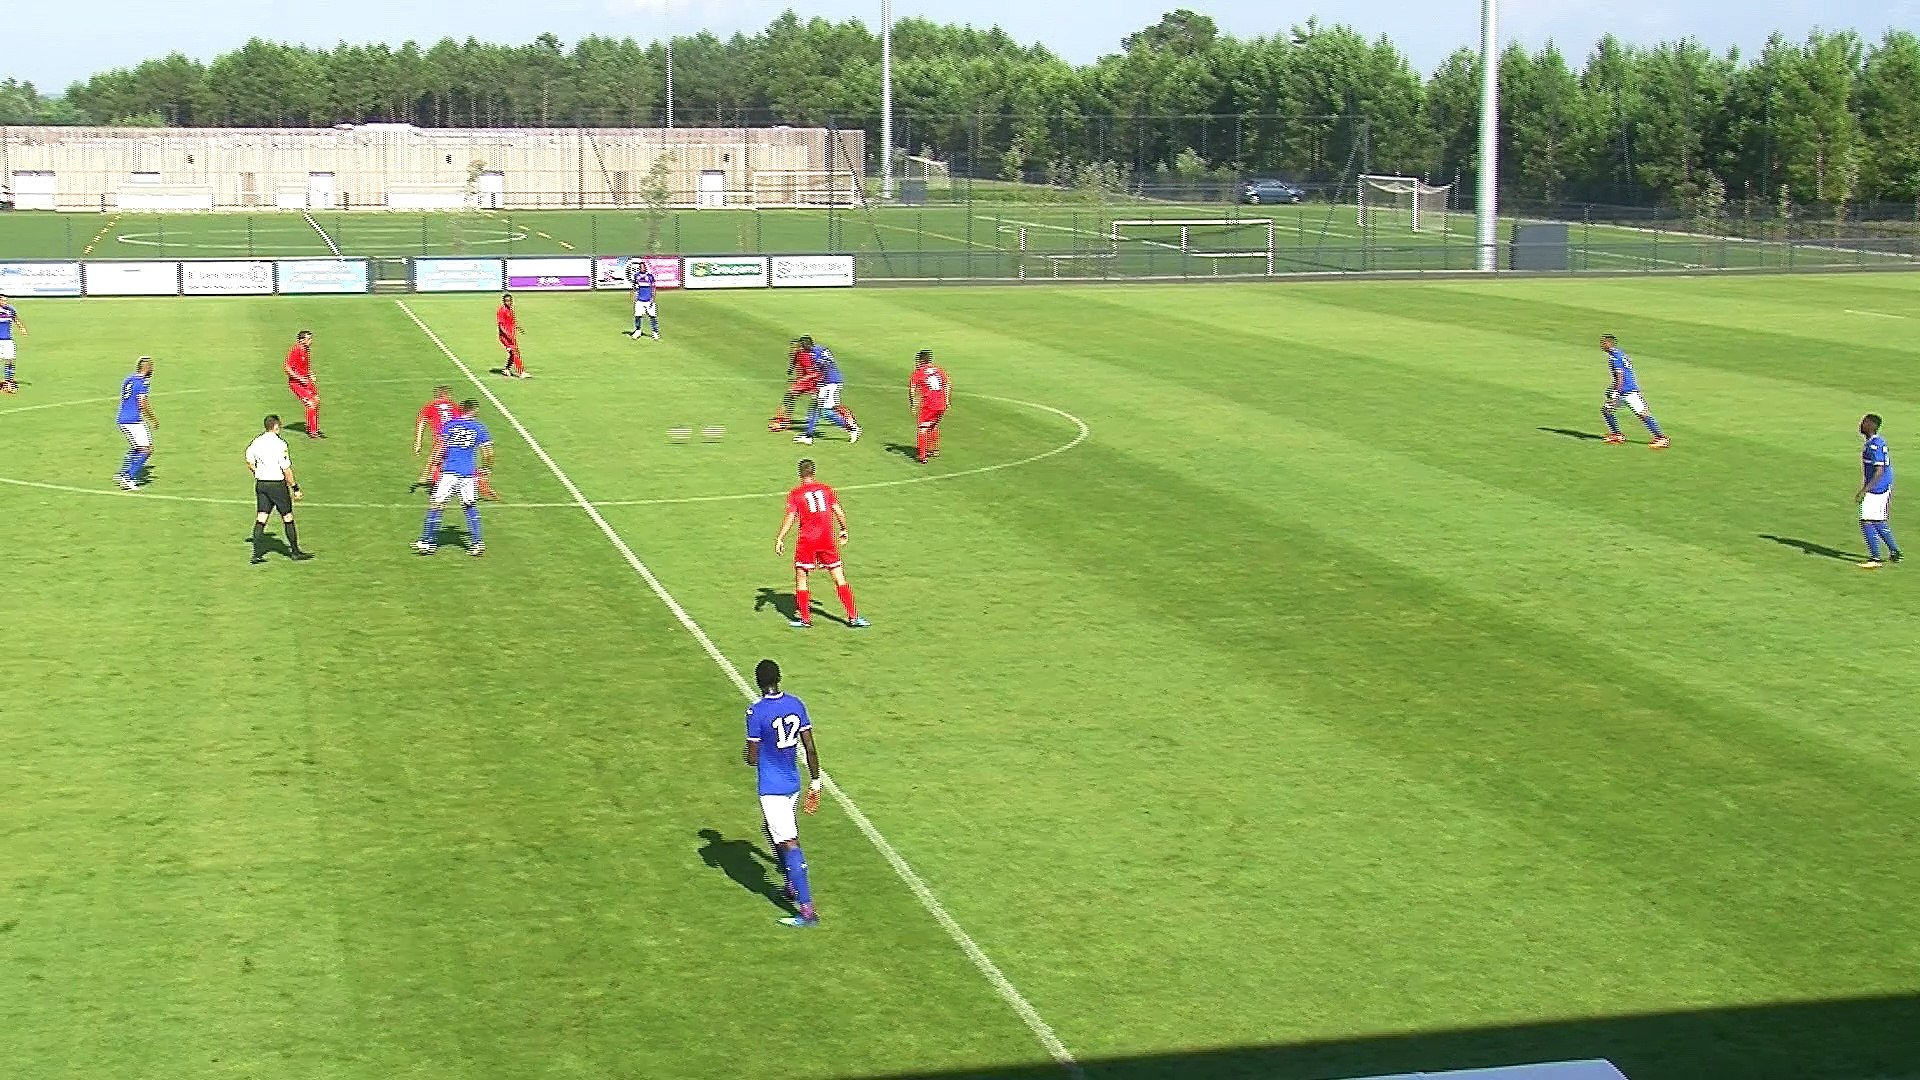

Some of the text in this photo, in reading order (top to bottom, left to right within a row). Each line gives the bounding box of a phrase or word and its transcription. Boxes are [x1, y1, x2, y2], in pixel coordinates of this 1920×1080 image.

[447, 426, 477, 448] 23
[804, 490, 827, 512] 11
[772, 714, 801, 749] 12
